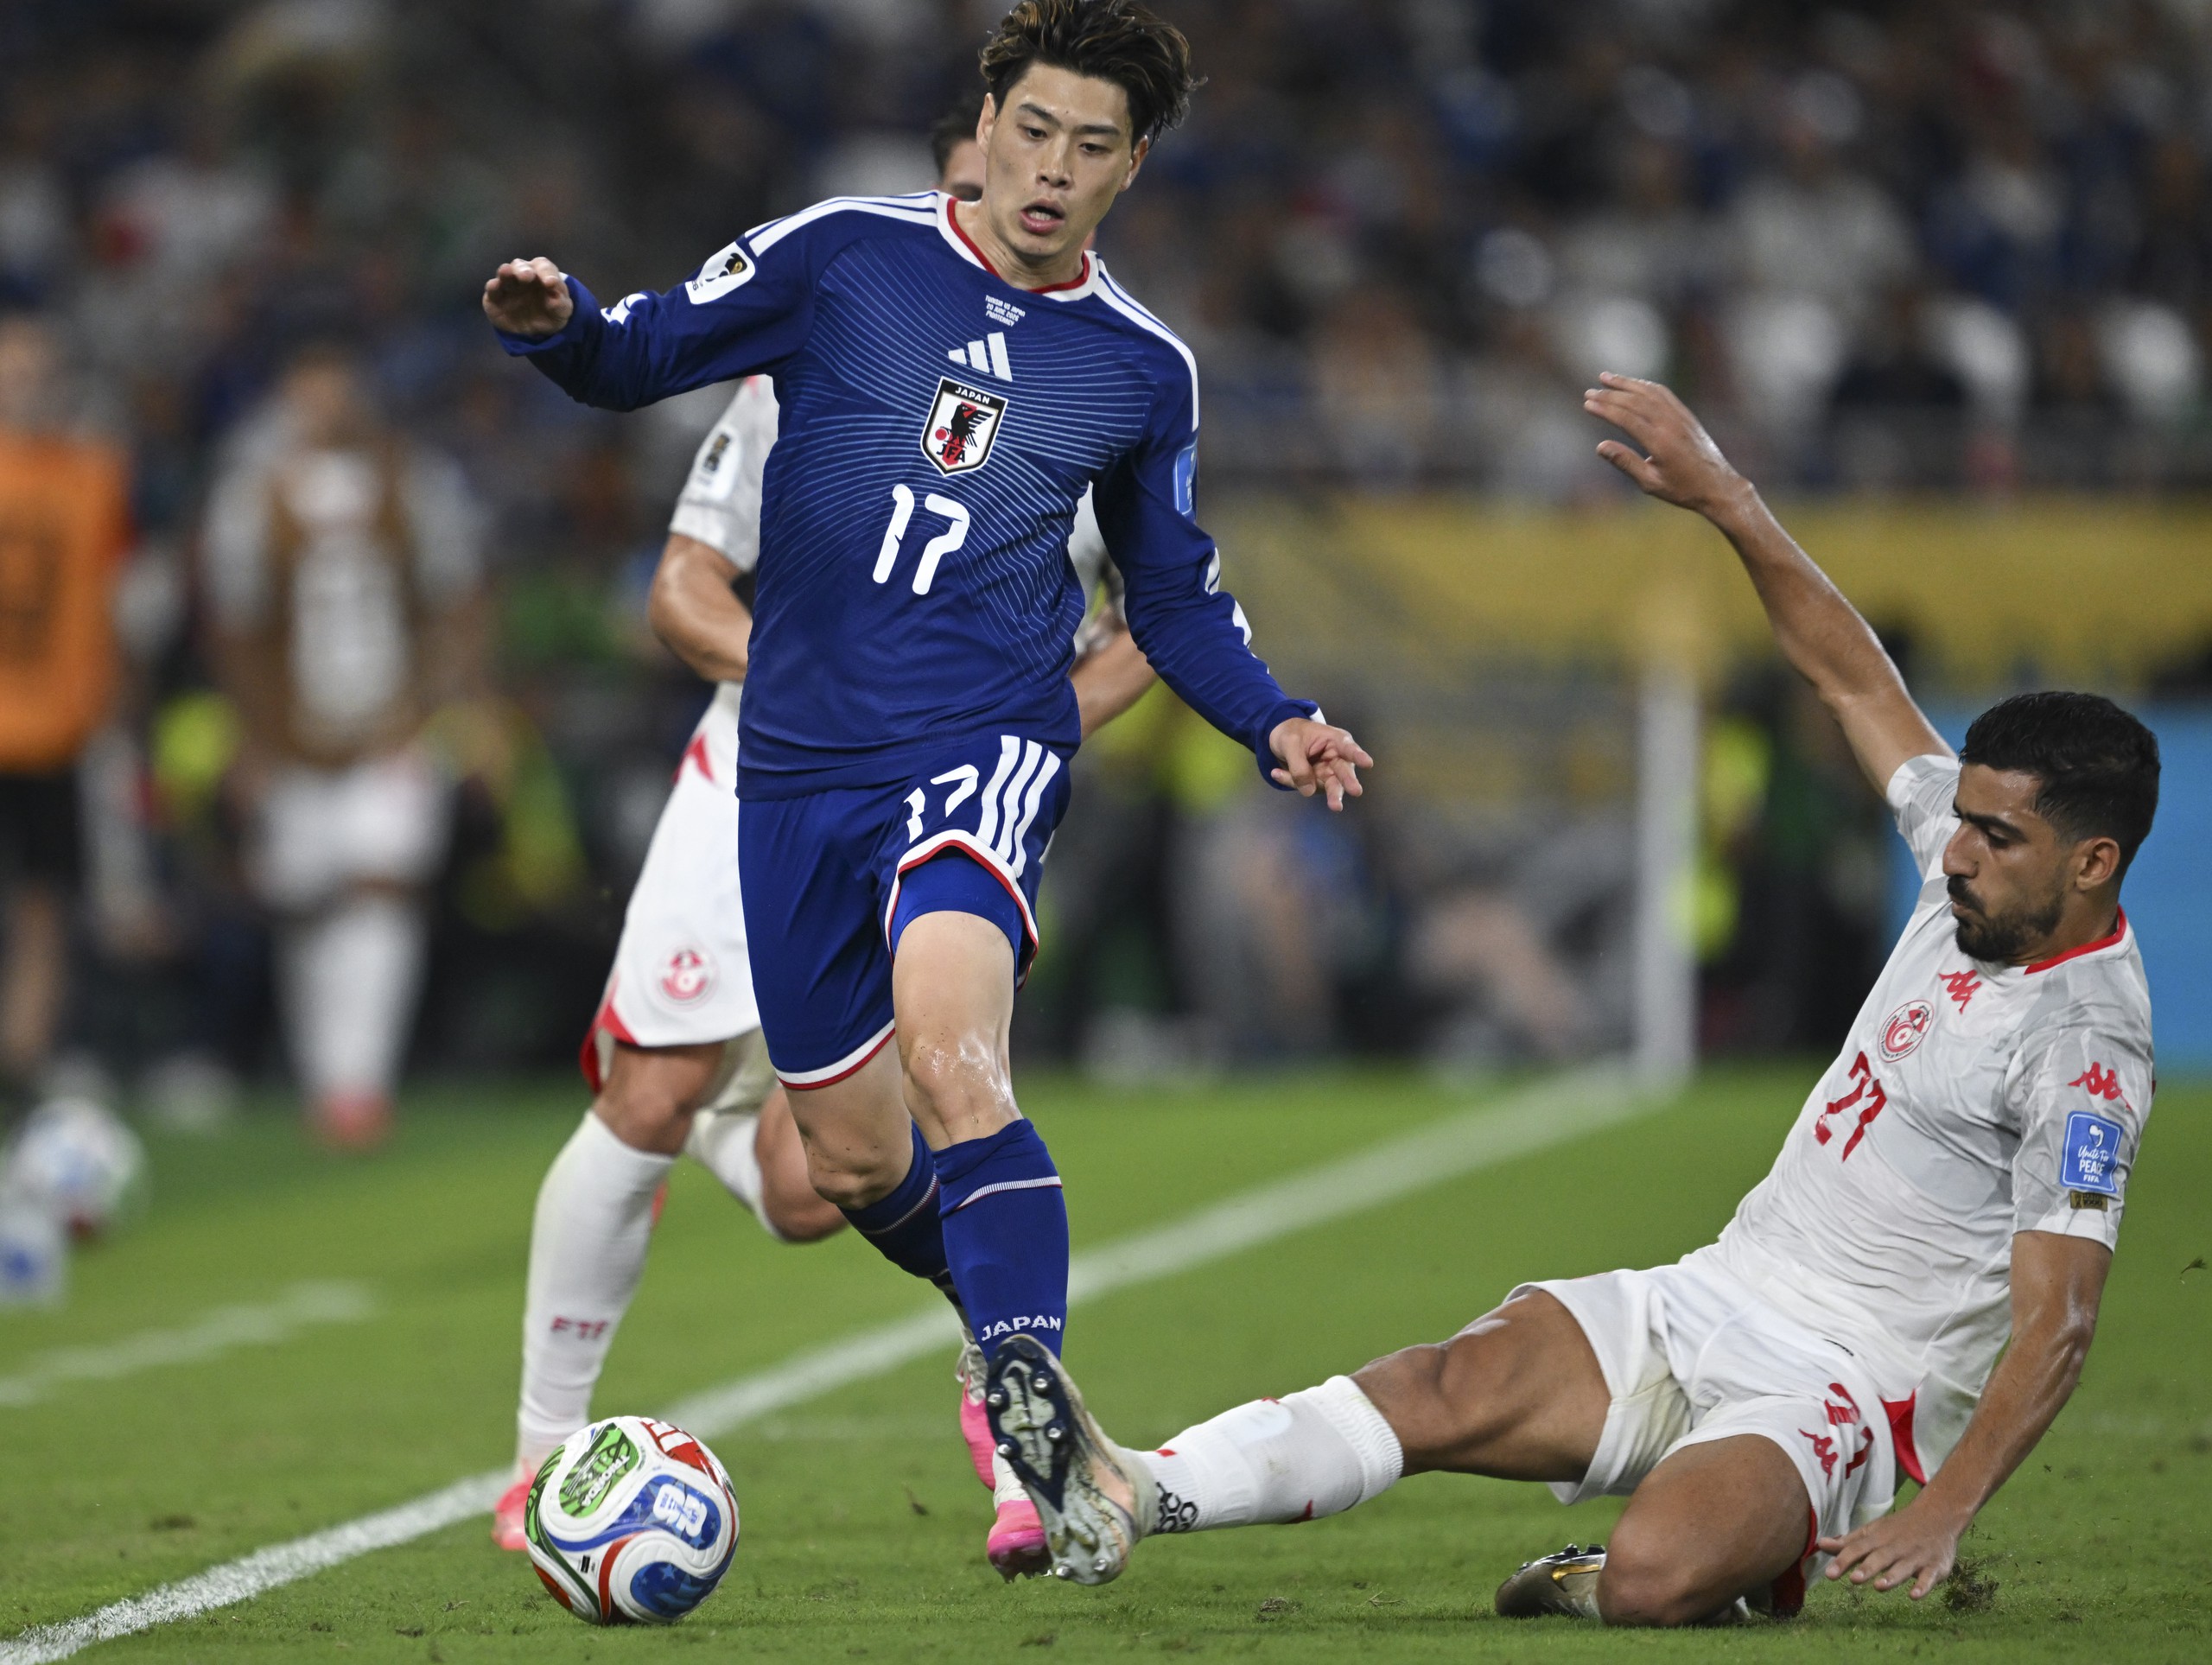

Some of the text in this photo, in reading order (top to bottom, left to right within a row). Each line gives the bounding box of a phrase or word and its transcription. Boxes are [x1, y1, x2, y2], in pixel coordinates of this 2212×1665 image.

[955, 386, 990, 404] JAPAN
[936, 443, 966, 463] JFA
[873, 484, 970, 595] 17
[904, 764, 979, 844] 17
[2079, 1159, 2106, 1176] PEACE
[981, 1315, 1061, 1342] JAPAN
[1824, 1382, 1875, 1480] 21
